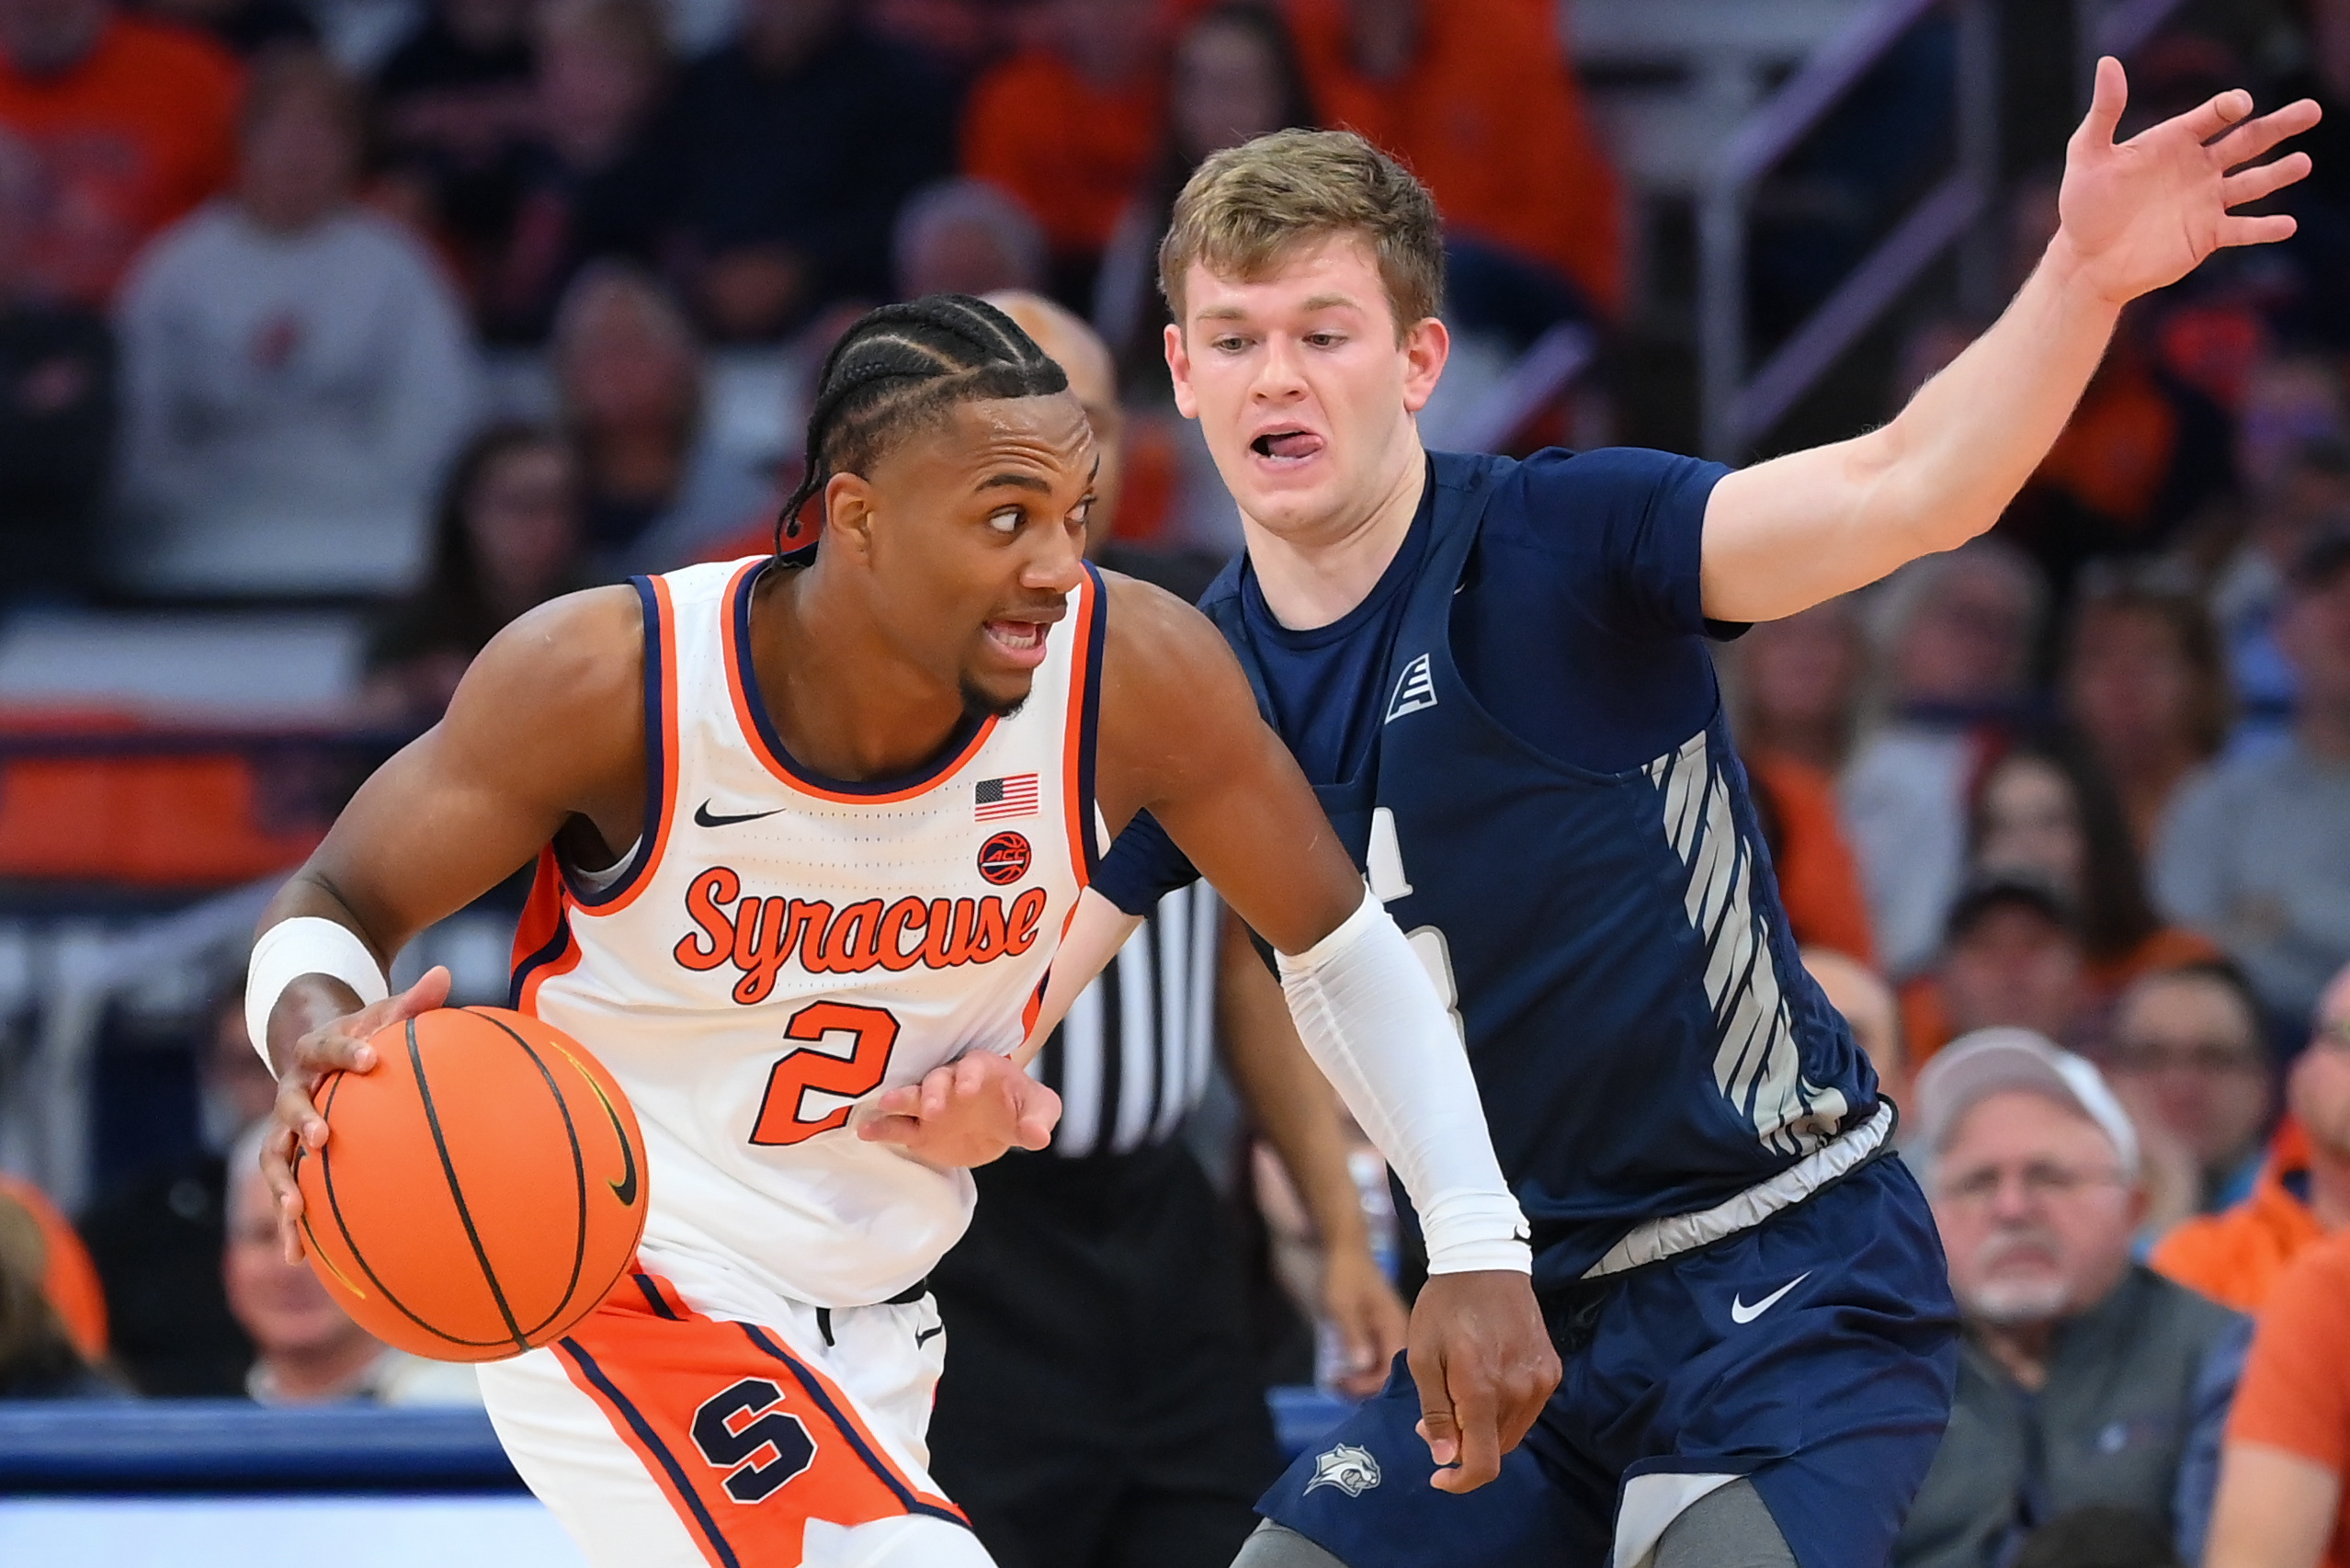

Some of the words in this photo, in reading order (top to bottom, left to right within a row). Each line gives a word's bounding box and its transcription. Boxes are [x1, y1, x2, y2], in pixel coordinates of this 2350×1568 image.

[985, 848, 1027, 862] ACC
[674, 866, 1047, 1005] Syracuse
[748, 1000, 901, 1145] 2
[689, 1377, 818, 1504] S
